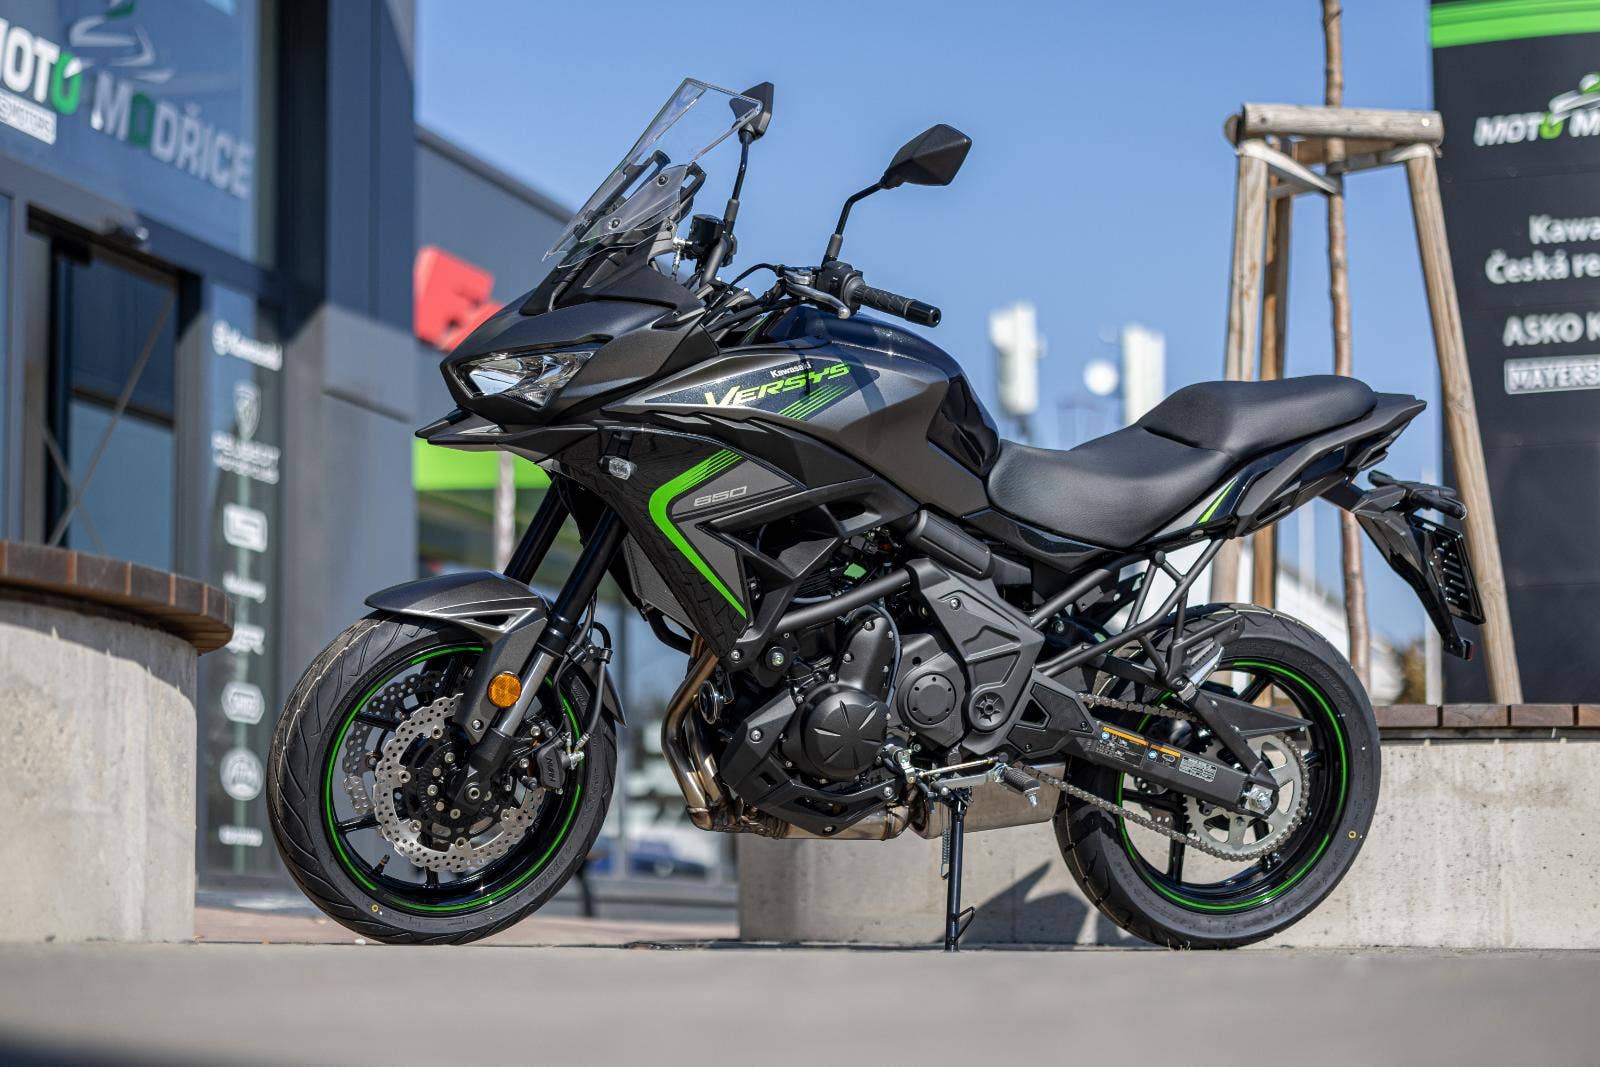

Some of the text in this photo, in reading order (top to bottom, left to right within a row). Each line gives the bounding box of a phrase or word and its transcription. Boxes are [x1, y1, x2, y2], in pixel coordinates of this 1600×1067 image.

[0, 18, 256, 200] OTO MODŘICE
[1485, 249, 1600, 284] Česká re
[1503, 312, 1584, 347] ASKO
[770, 361, 812, 379] Kawasaki
[693, 485, 748, 507] 650
